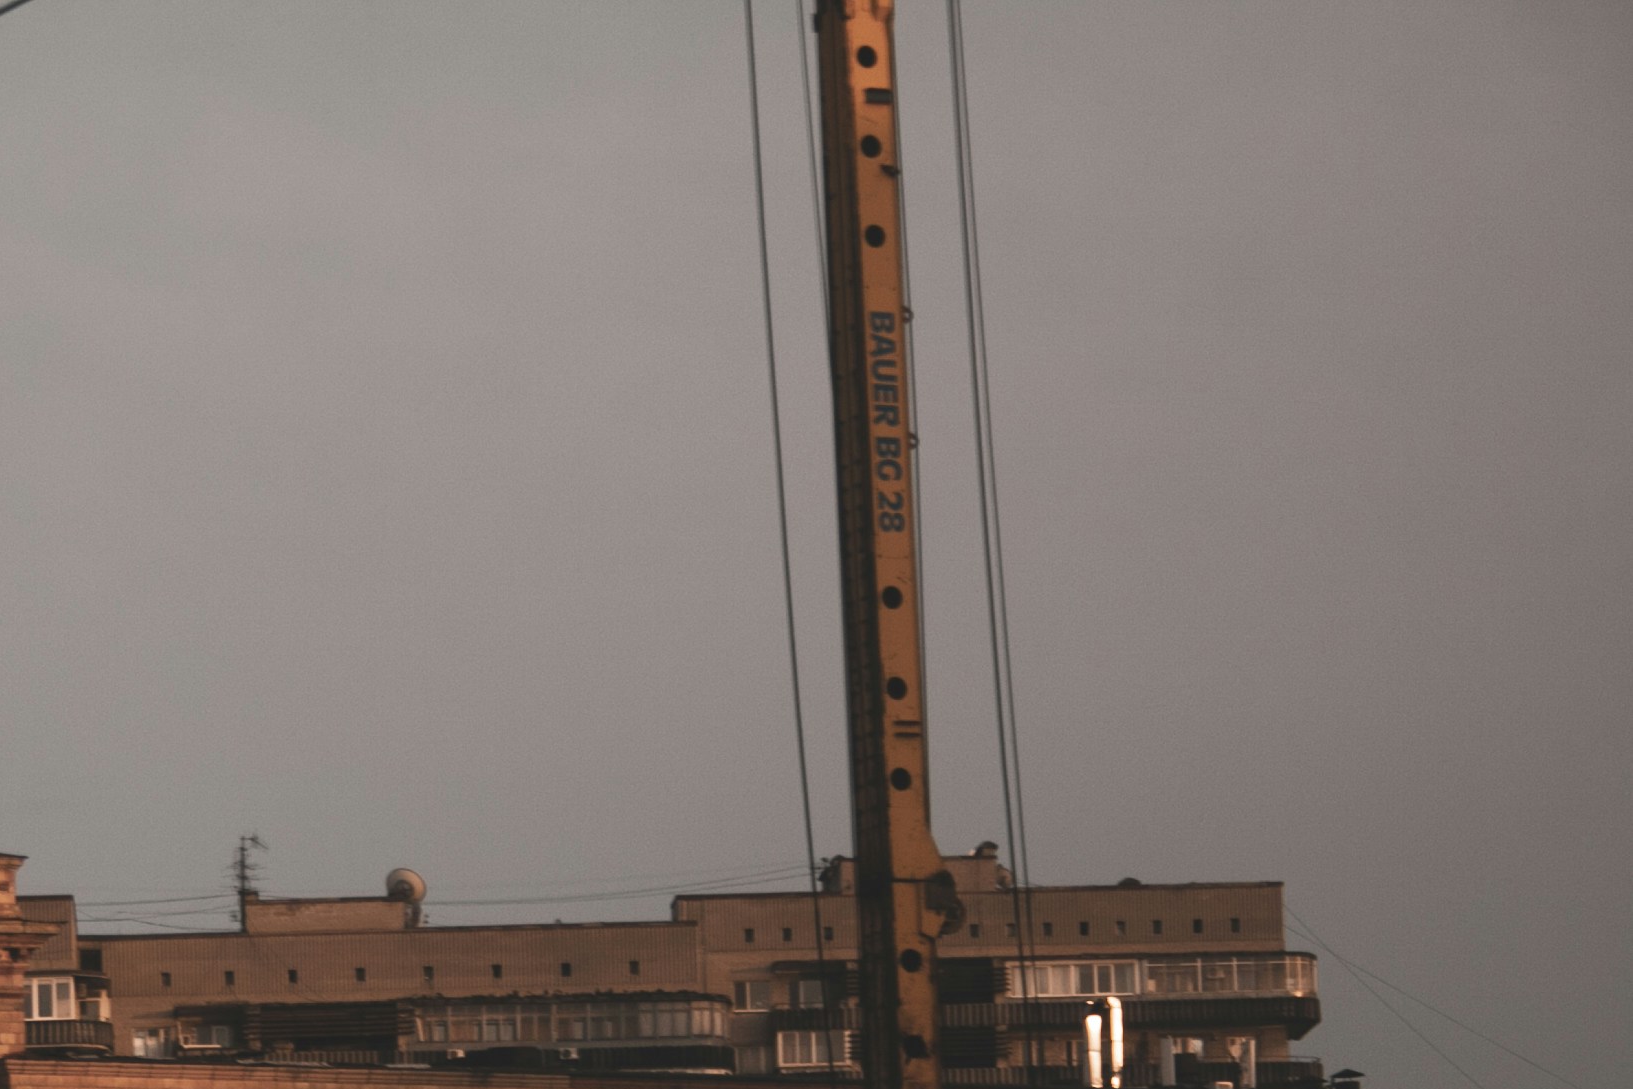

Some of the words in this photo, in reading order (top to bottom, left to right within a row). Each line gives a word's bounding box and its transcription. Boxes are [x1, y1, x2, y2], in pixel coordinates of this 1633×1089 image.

[869, 310, 900, 428] BAUER
[875, 436, 904, 482] BG
[877, 491, 906, 534] 28
